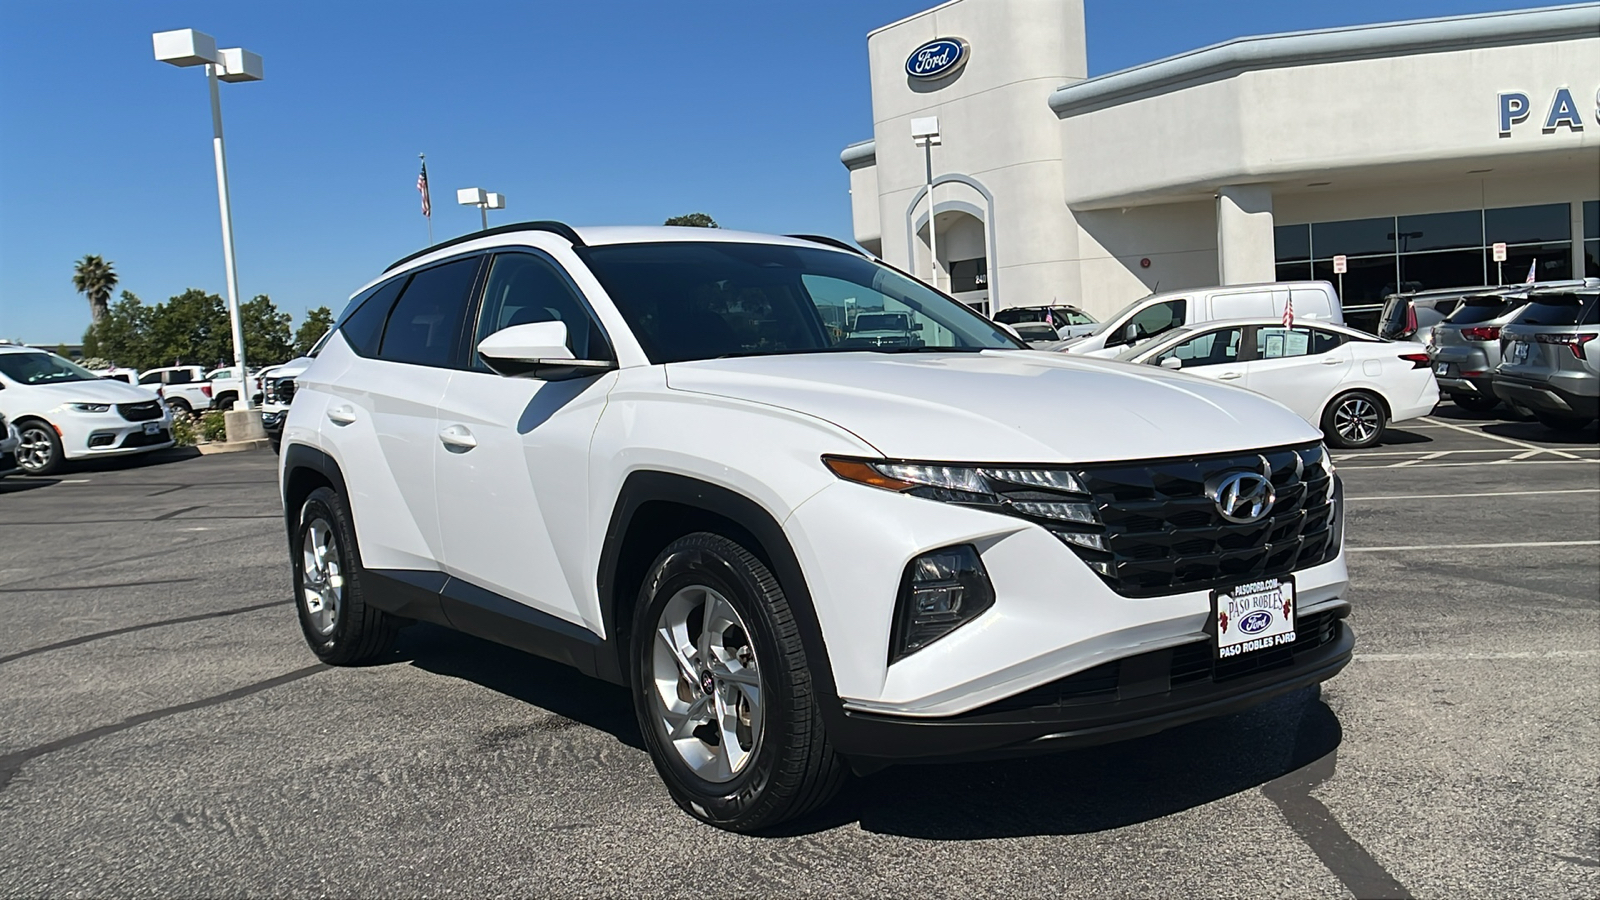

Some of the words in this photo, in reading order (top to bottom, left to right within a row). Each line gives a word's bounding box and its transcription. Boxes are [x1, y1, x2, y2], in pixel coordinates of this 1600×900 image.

[915, 45, 950, 73] Ford
[1498, 86, 1600, 136] PA
[1235, 578, 1278, 597] PASOFORD.COM
[1228, 598, 1250, 621] PASO
[1253, 592, 1283, 611] ROBLES
[1246, 613, 1268, 631] Ford
[1220, 644, 1242, 658] PASO
[1243, 635, 1274, 653] ROBLES
